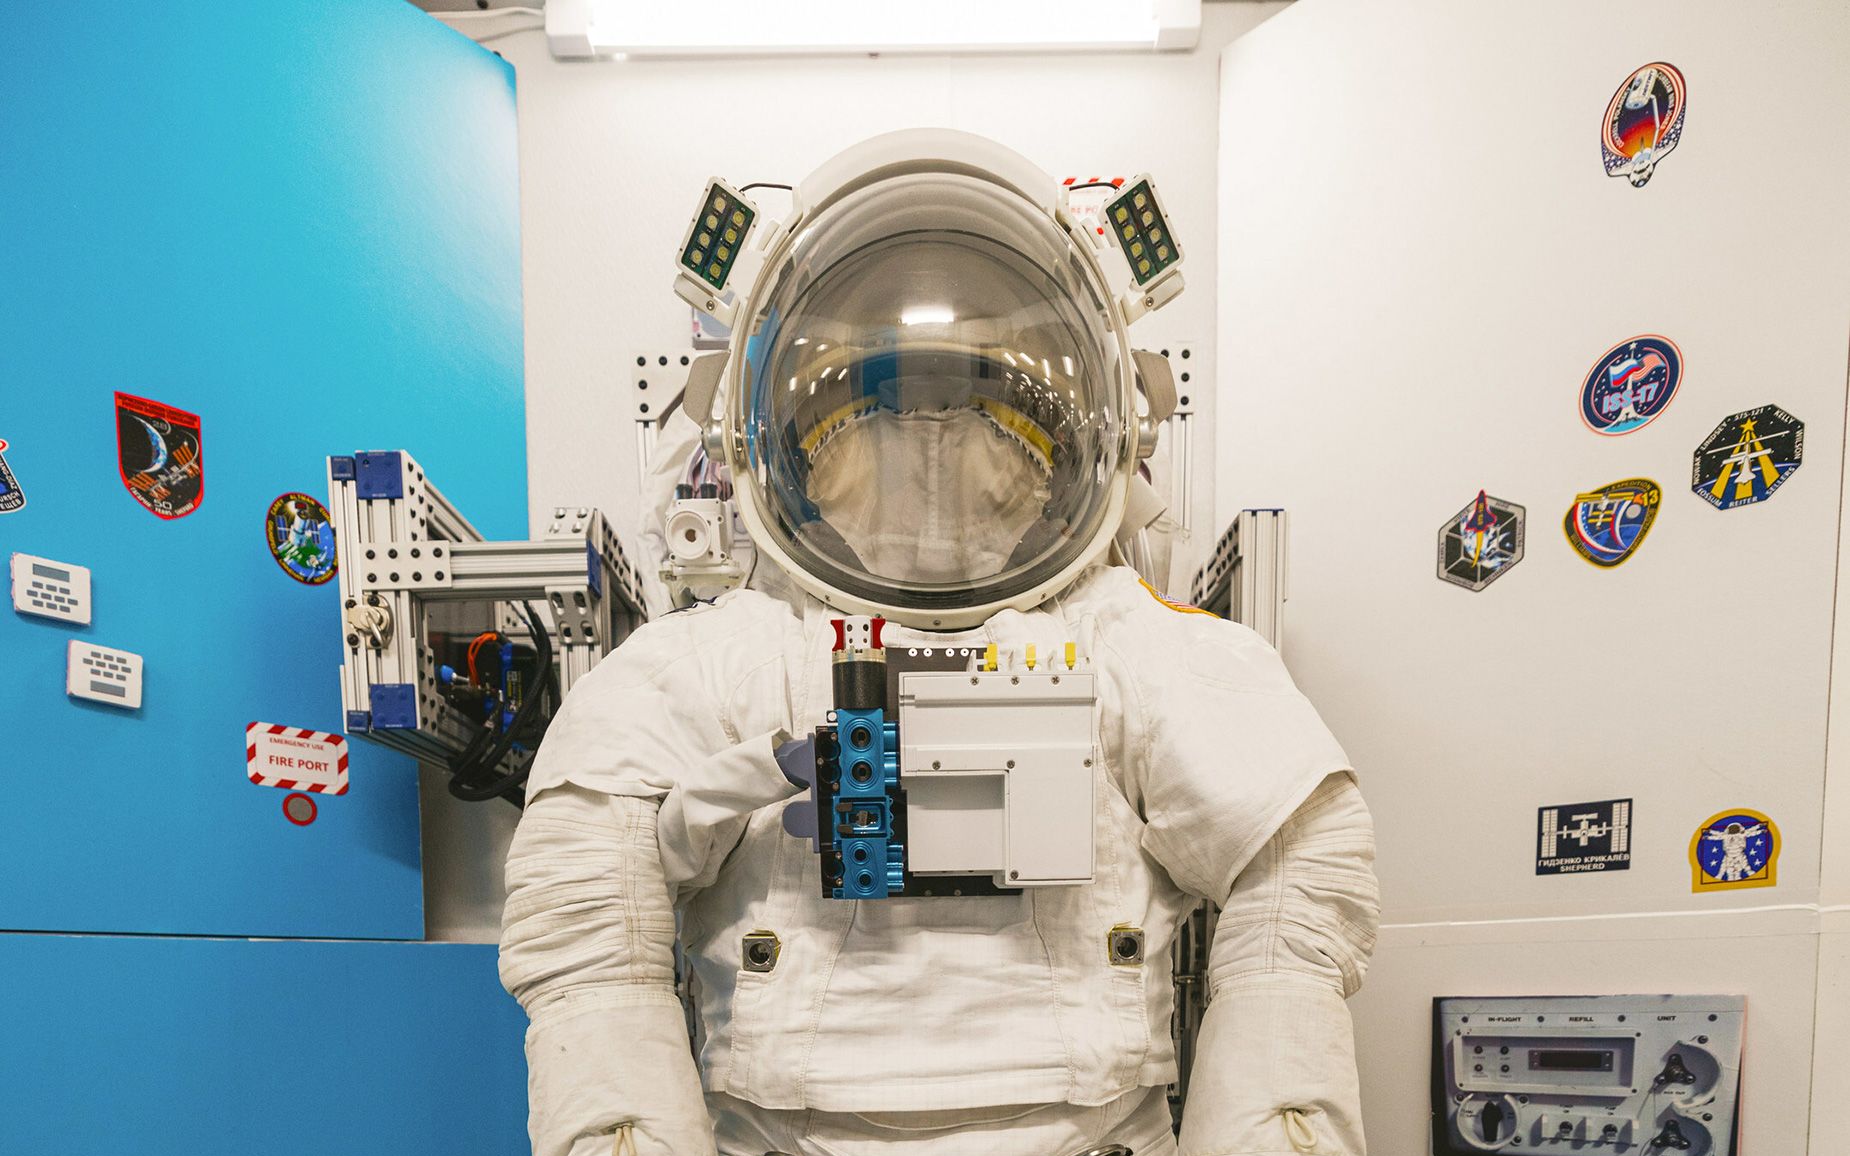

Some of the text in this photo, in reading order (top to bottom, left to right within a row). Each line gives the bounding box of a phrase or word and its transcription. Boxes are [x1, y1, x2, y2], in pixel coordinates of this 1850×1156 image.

[1602, 381, 1659, 414] ISS-17
[1773, 408, 1796, 425] KELLY
[1700, 421, 1728, 451] LINDSEY
[1793, 428, 1804, 460] WILSON
[1765, 466, 1796, 495] SELLERS
[153, 498, 173, 510] 50
[1642, 489, 1659, 507] 13
[1696, 488, 1723, 507] FOSSUM
[1728, 496, 1758, 508] REITER
[269, 737, 324, 751] EMERGENCY USE
[269, 755, 329, 772] FIRE PORT
[1560, 862, 1606, 872] SHEPHERD
